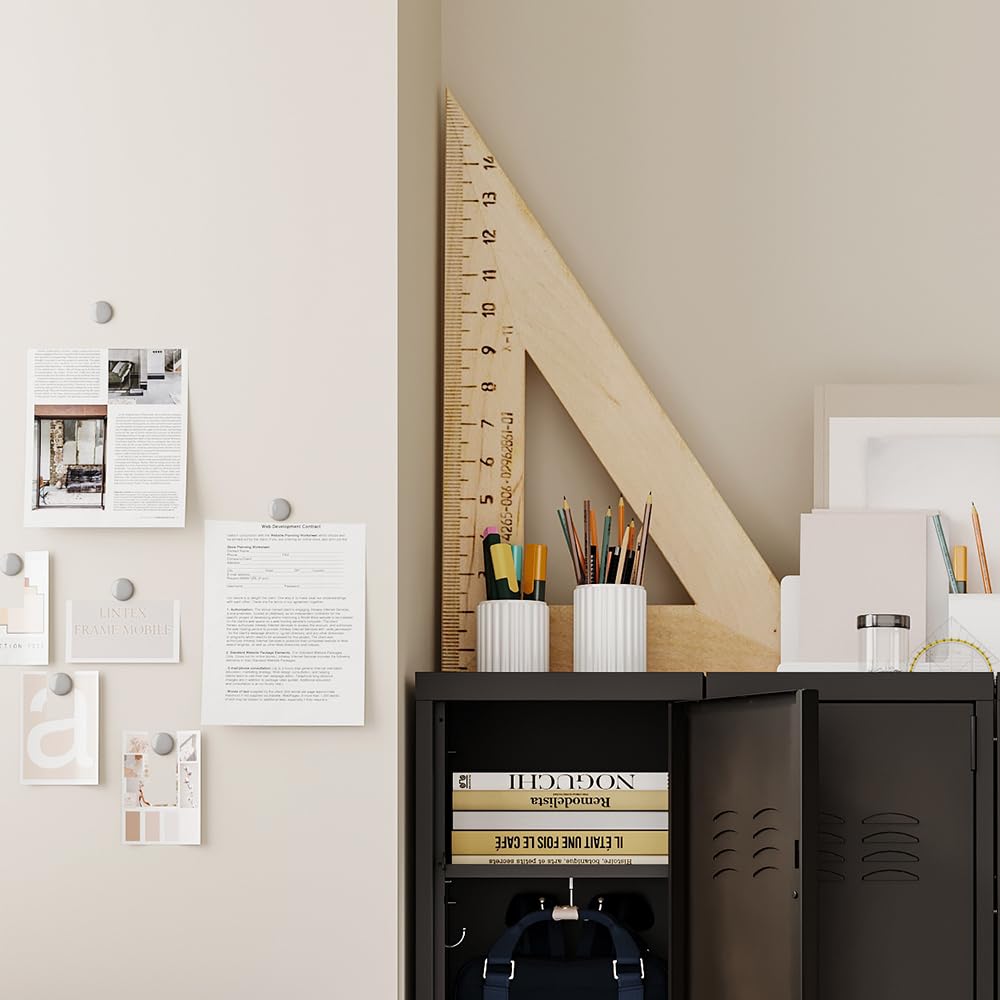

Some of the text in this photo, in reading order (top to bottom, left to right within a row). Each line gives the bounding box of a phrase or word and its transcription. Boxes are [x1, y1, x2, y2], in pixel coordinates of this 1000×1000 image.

[483, 156, 497, 170] 14
[482, 192, 497, 207] 13
[482, 229, 496, 245] 12
[482, 269, 497, 281] 11
[482, 302, 496, 318] 10
[481, 345, 496, 355] 9
[481, 381, 495, 392] 8
[480, 419, 494, 428] 7
[480, 457, 494, 467] 6
[480, 495, 494, 505] 5
[74, 624, 120, 636] FRAME
[508, 774, 635, 790] NOGUCHI
[530, 796, 611, 808] Remodelista
[494, 836, 623, 851] IL ÉTAIT UNE FOIS LE CAFÉ
